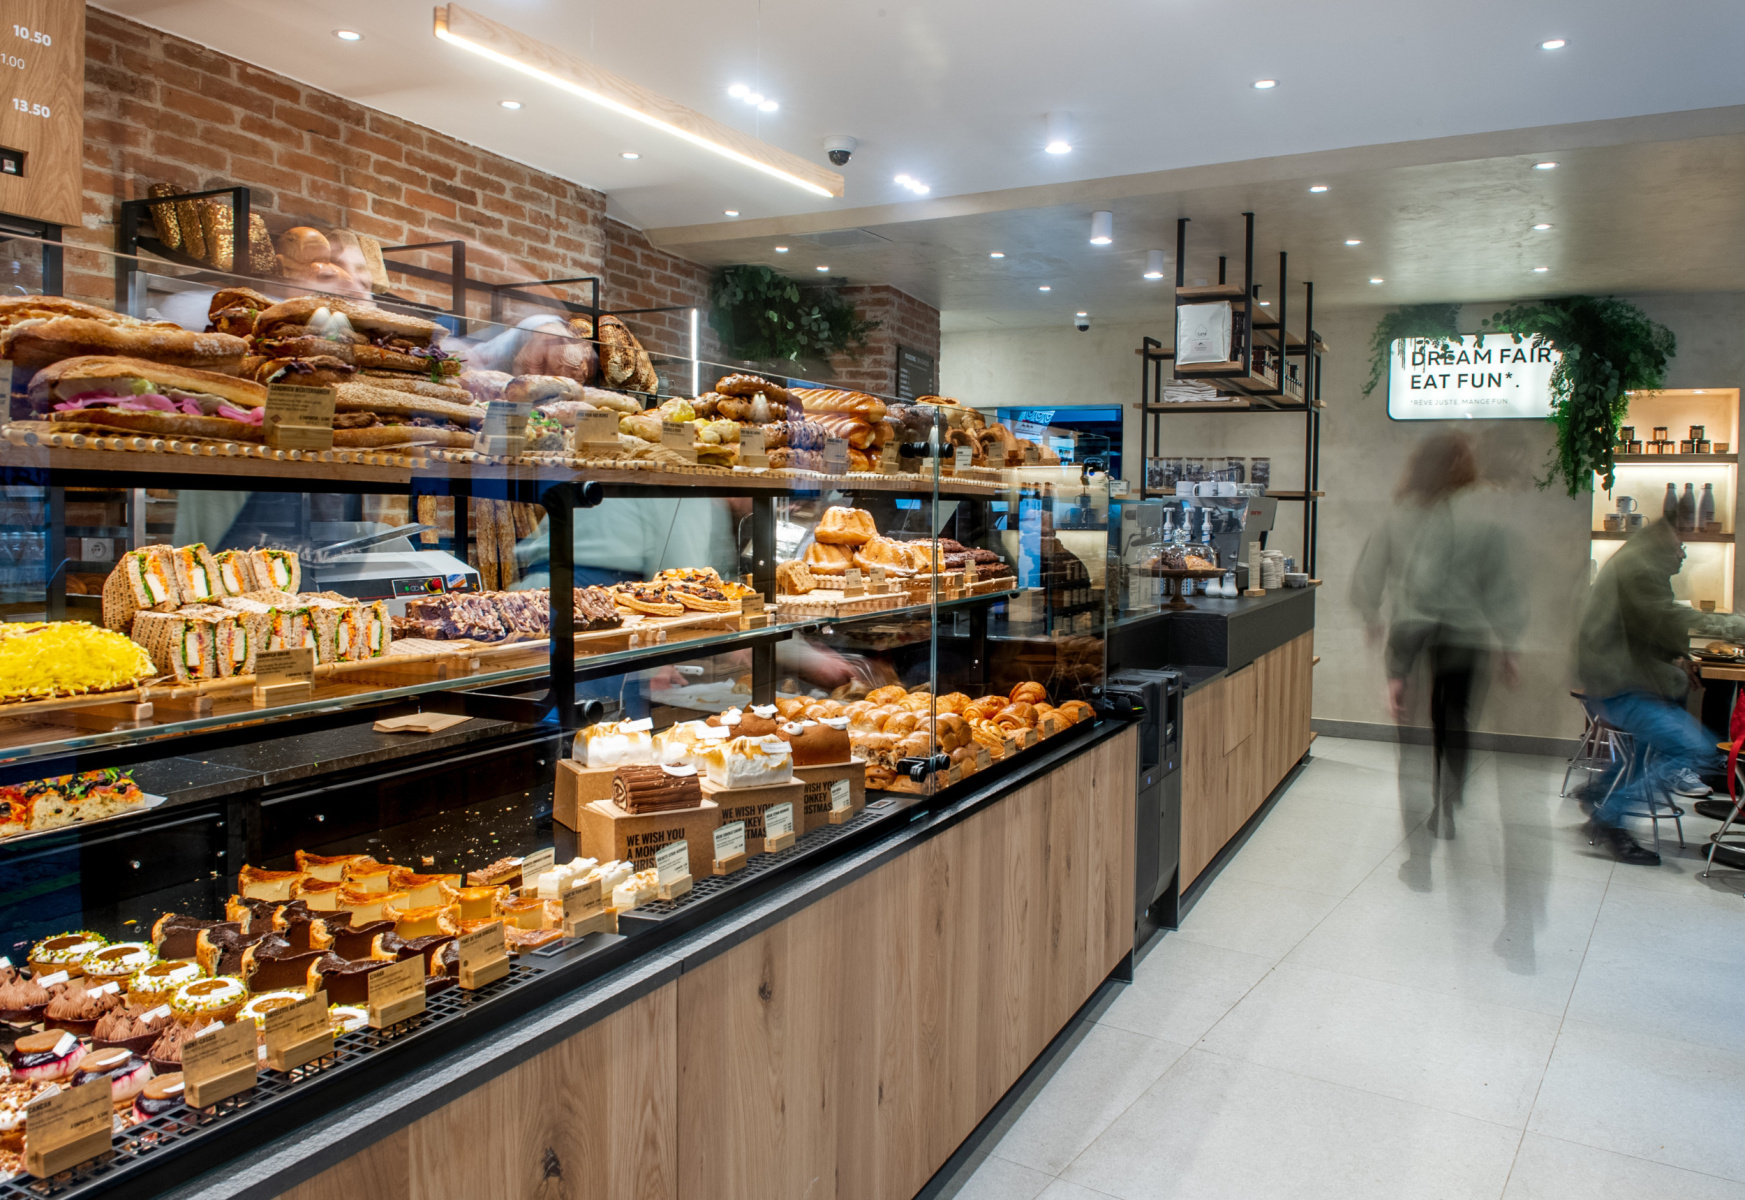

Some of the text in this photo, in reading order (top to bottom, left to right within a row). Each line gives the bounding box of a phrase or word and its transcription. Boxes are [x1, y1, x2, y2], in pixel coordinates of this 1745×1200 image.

[13, 24, 52, 47] 10.50
[12, 98, 51, 118] 13.50
[1411, 348, 1492, 366] DREAM
[1411, 374, 1450, 389] EAT
[722, 808, 733, 819] WE
[735, 805, 756, 817] WISH
[626, 828, 685, 847] WE WISH YOU
[626, 848, 633, 860] A
[27, 1101, 51, 1114] CANCAN
